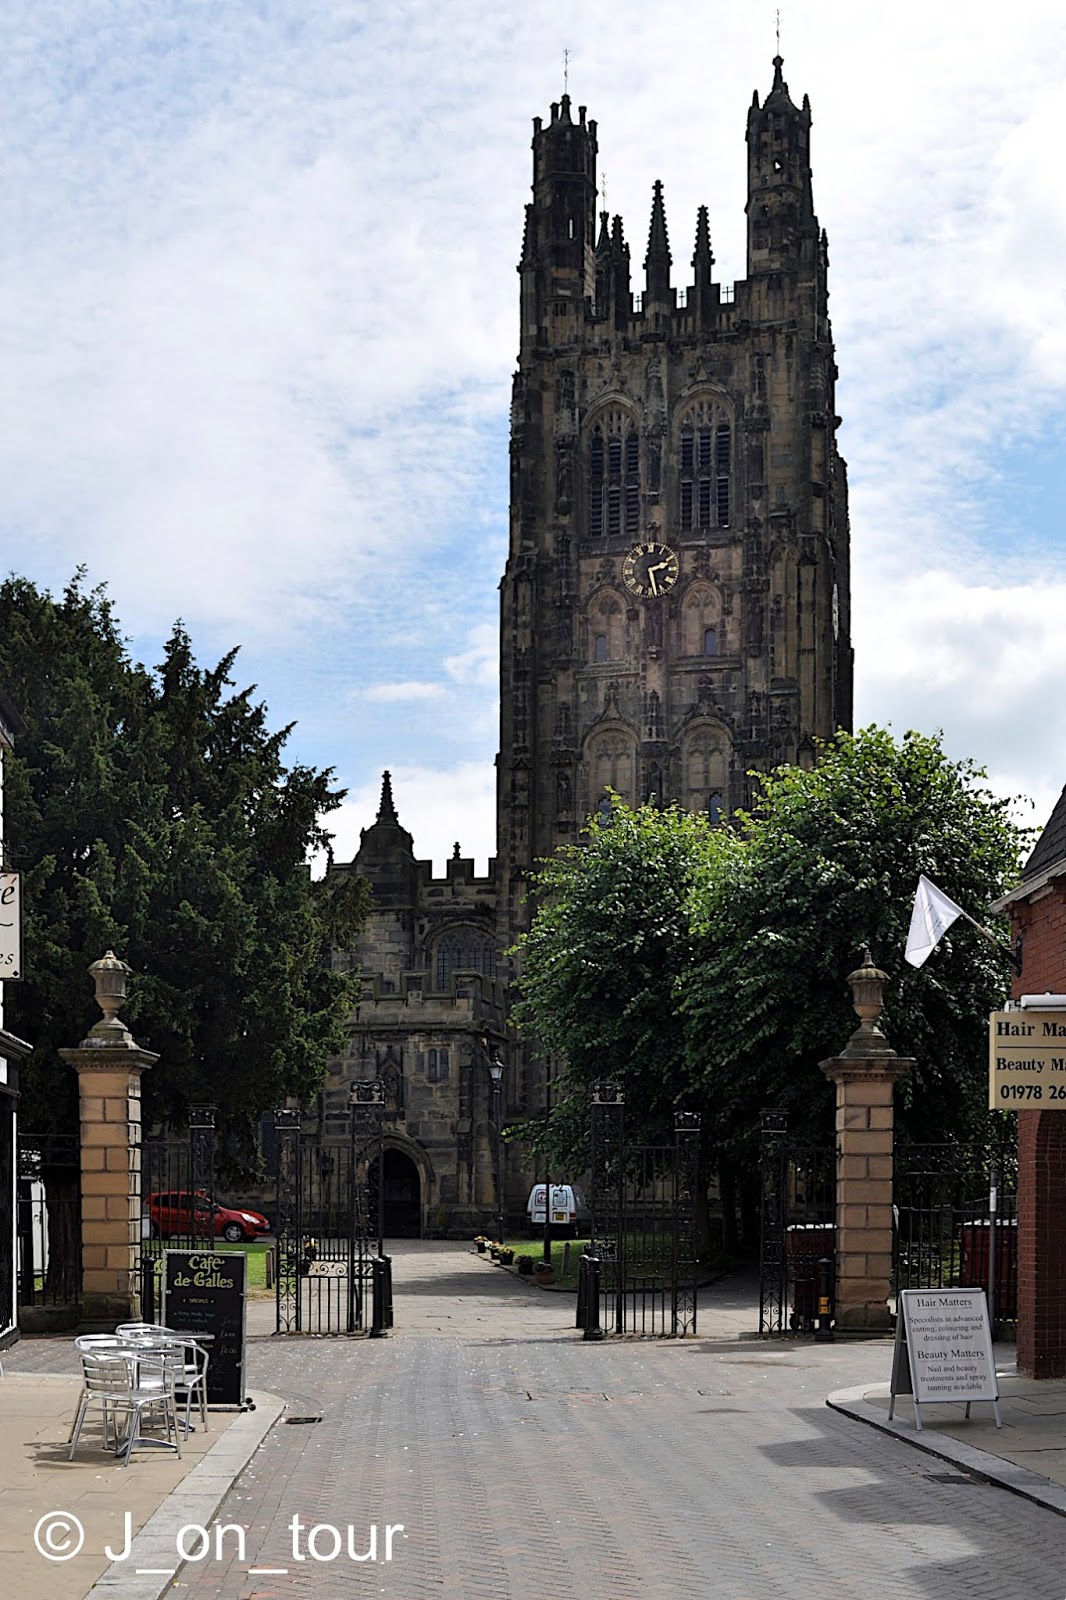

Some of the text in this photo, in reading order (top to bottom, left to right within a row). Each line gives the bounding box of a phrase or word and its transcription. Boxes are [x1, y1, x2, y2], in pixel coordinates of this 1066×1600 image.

[996, 1021, 1035, 1036] Hair
[996, 1057, 1066, 1073] Beauty M
[1000, 1085, 1066, 1100] 01978 26
[188, 1255, 226, 1275] Cafe
[173, 1271, 234, 1288] de Galles
[917, 1298, 972, 1307] Hair Matters
[909, 1316, 944, 1324] Specialists
[938, 1325, 969, 1333] colouring
[917, 1349, 985, 1361] Beauty Matters
[956, 1365, 977, 1373] beauty
